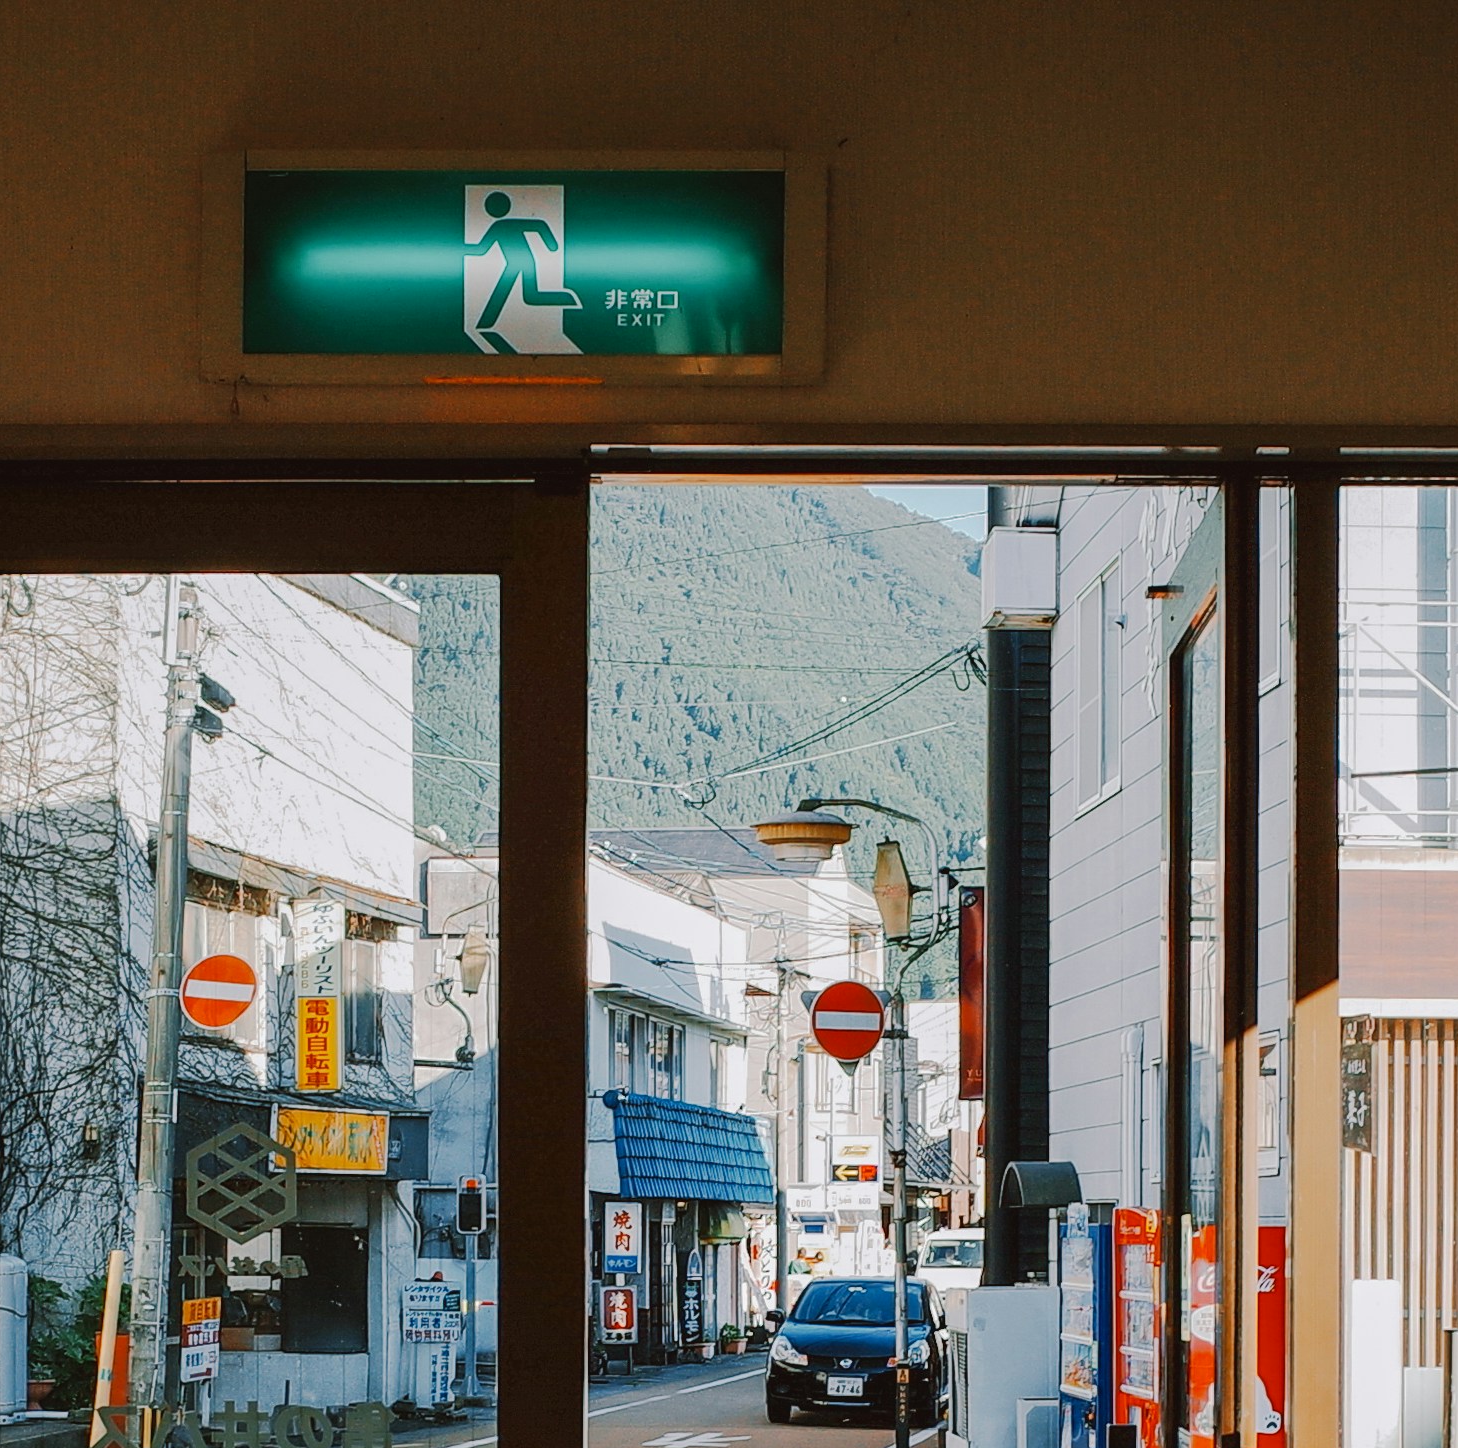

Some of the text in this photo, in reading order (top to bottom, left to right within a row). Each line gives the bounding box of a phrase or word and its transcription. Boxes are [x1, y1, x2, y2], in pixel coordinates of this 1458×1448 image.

[605, 289, 679, 310] 非常口
[617, 314, 665, 327] EXIT
[312, 903, 335, 995] ゆふいんツーリスト
[305, 1000, 330, 1088] 電動自転車
[613, 1209, 633, 1252] 焼肉
[607, 1258, 636, 1268] ホルモン
[609, 1291, 628, 1328] 焼肉
[682, 1299, 701, 1343] ホルモン
